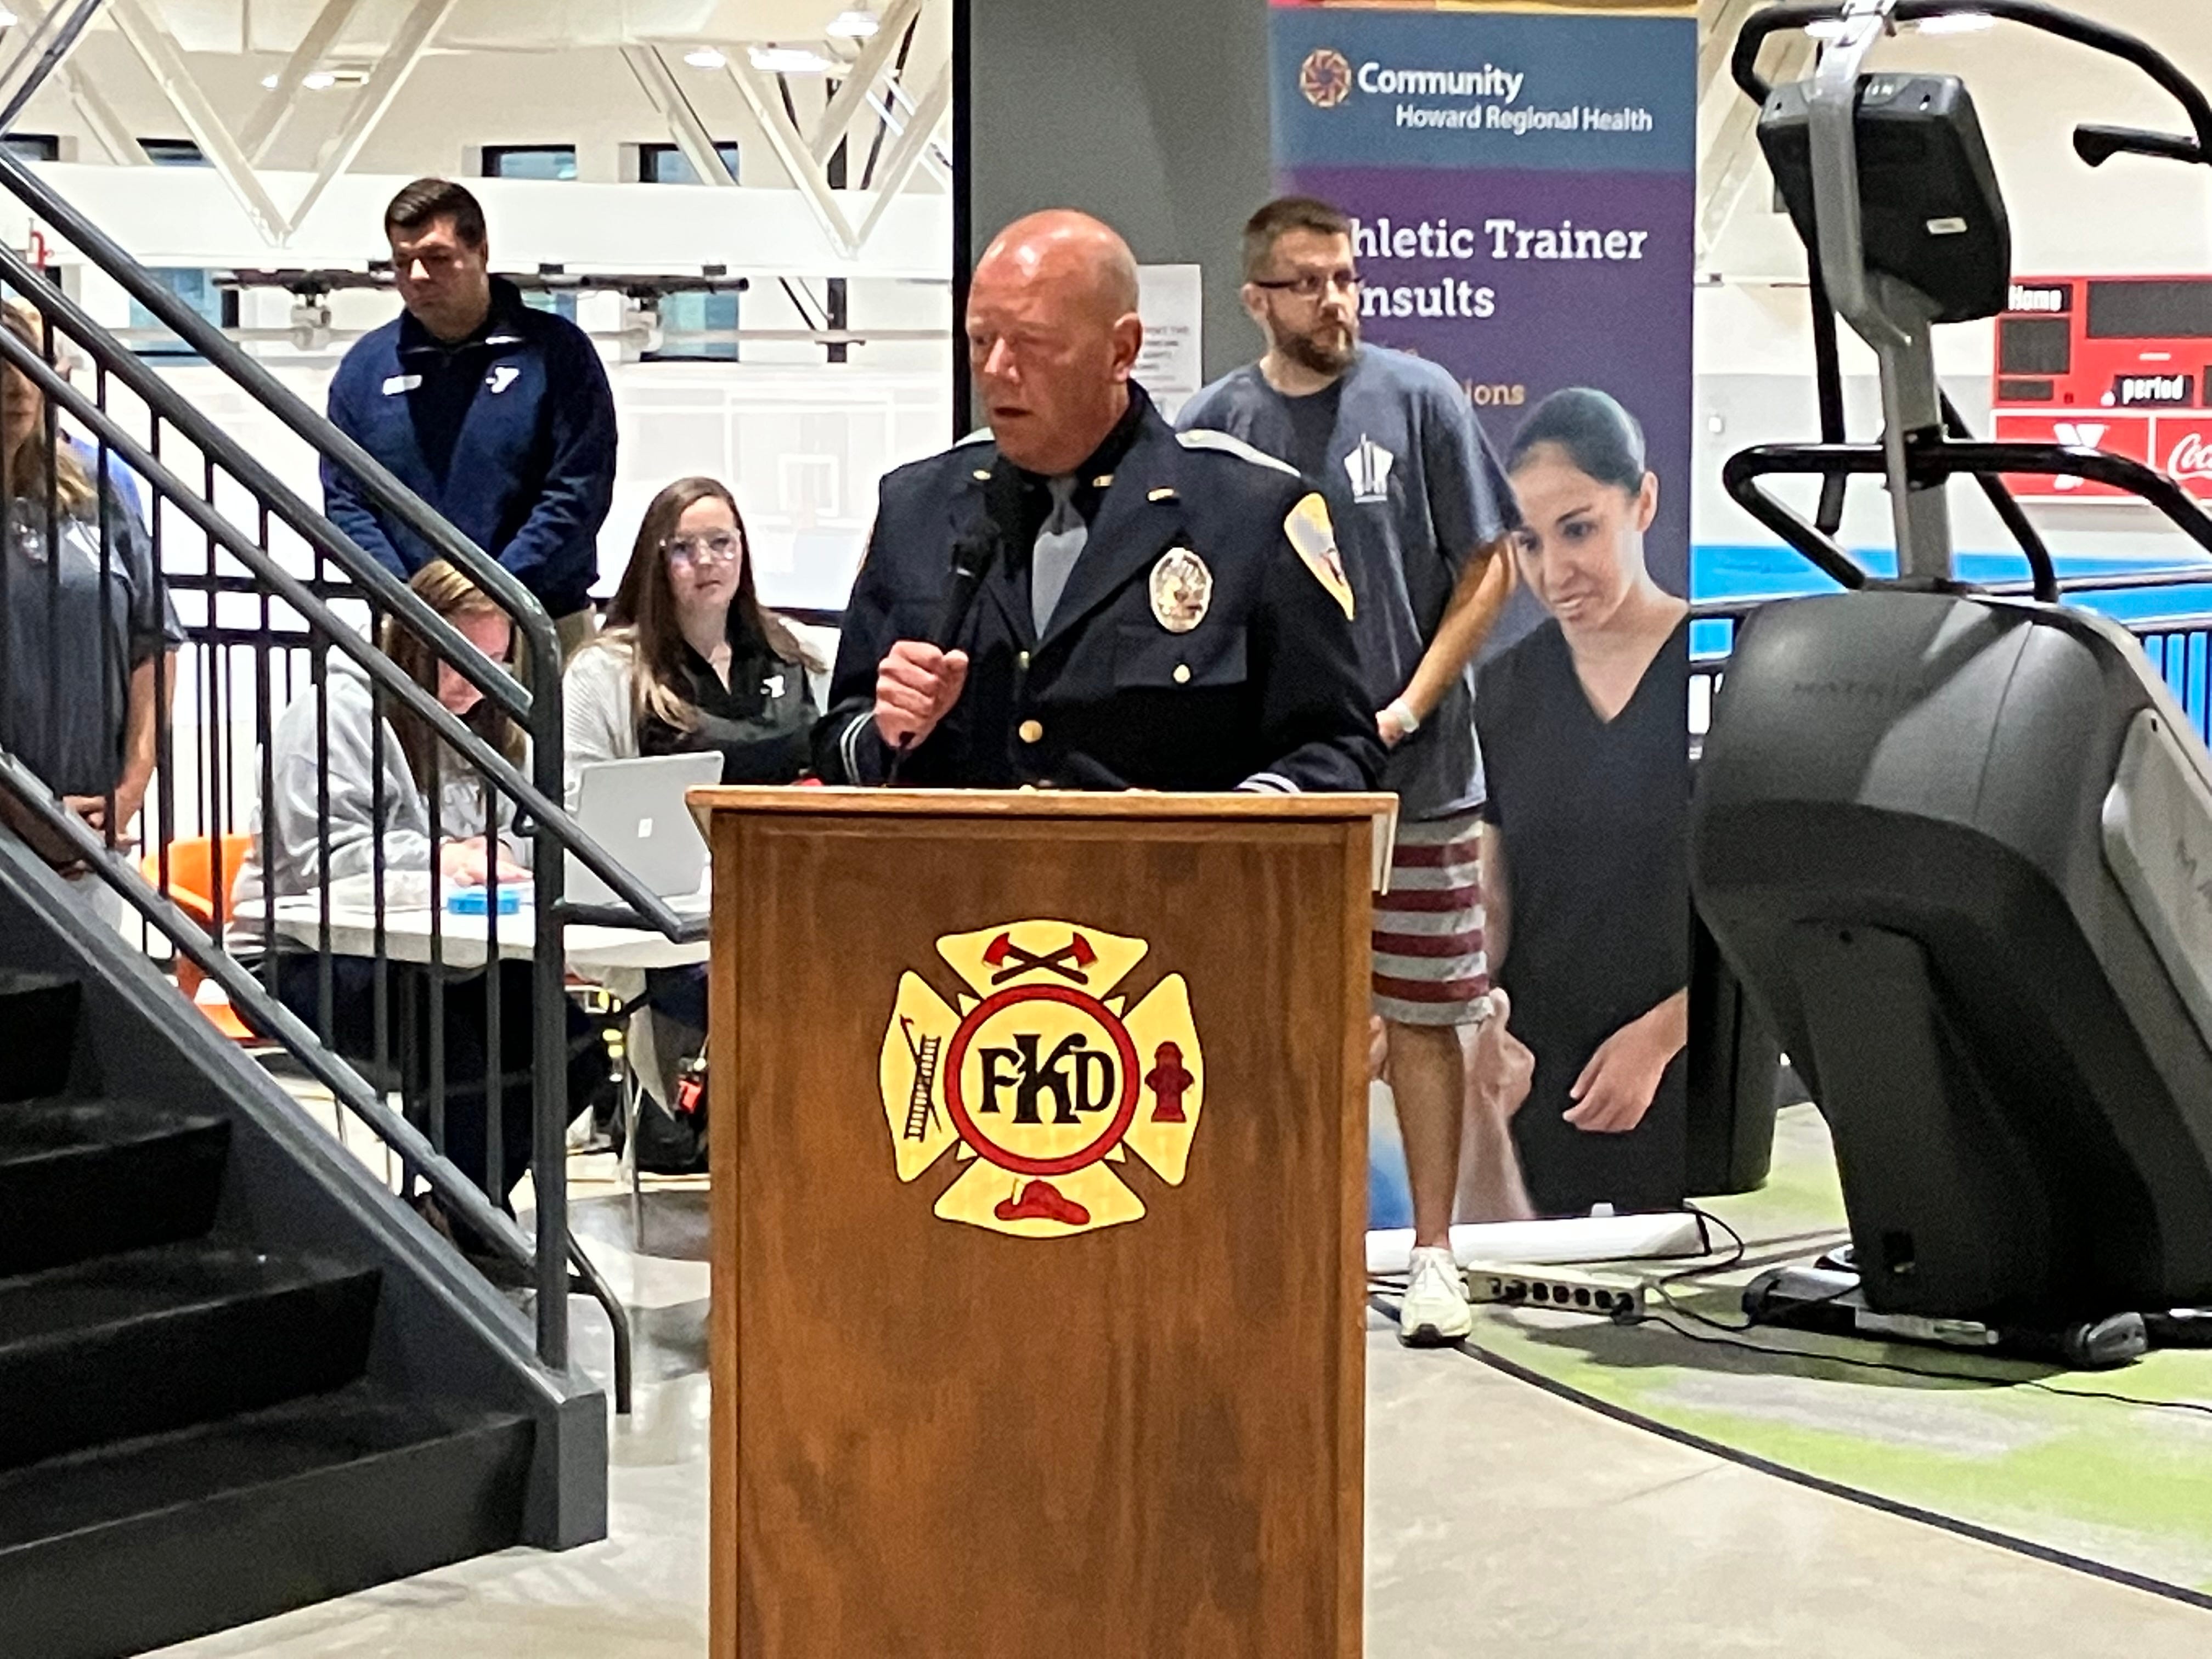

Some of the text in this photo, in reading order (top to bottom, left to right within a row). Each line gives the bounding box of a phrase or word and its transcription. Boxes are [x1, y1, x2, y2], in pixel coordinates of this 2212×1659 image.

[1357, 61, 1524, 104] Community
[1396, 103, 1653, 136] Howard Regional Health
[1350, 217, 1648, 261] hletic Trainer
[1359, 276, 1496, 318] nsults
[1464, 377, 1525, 405] ions
[2122, 374, 2185, 405] period
